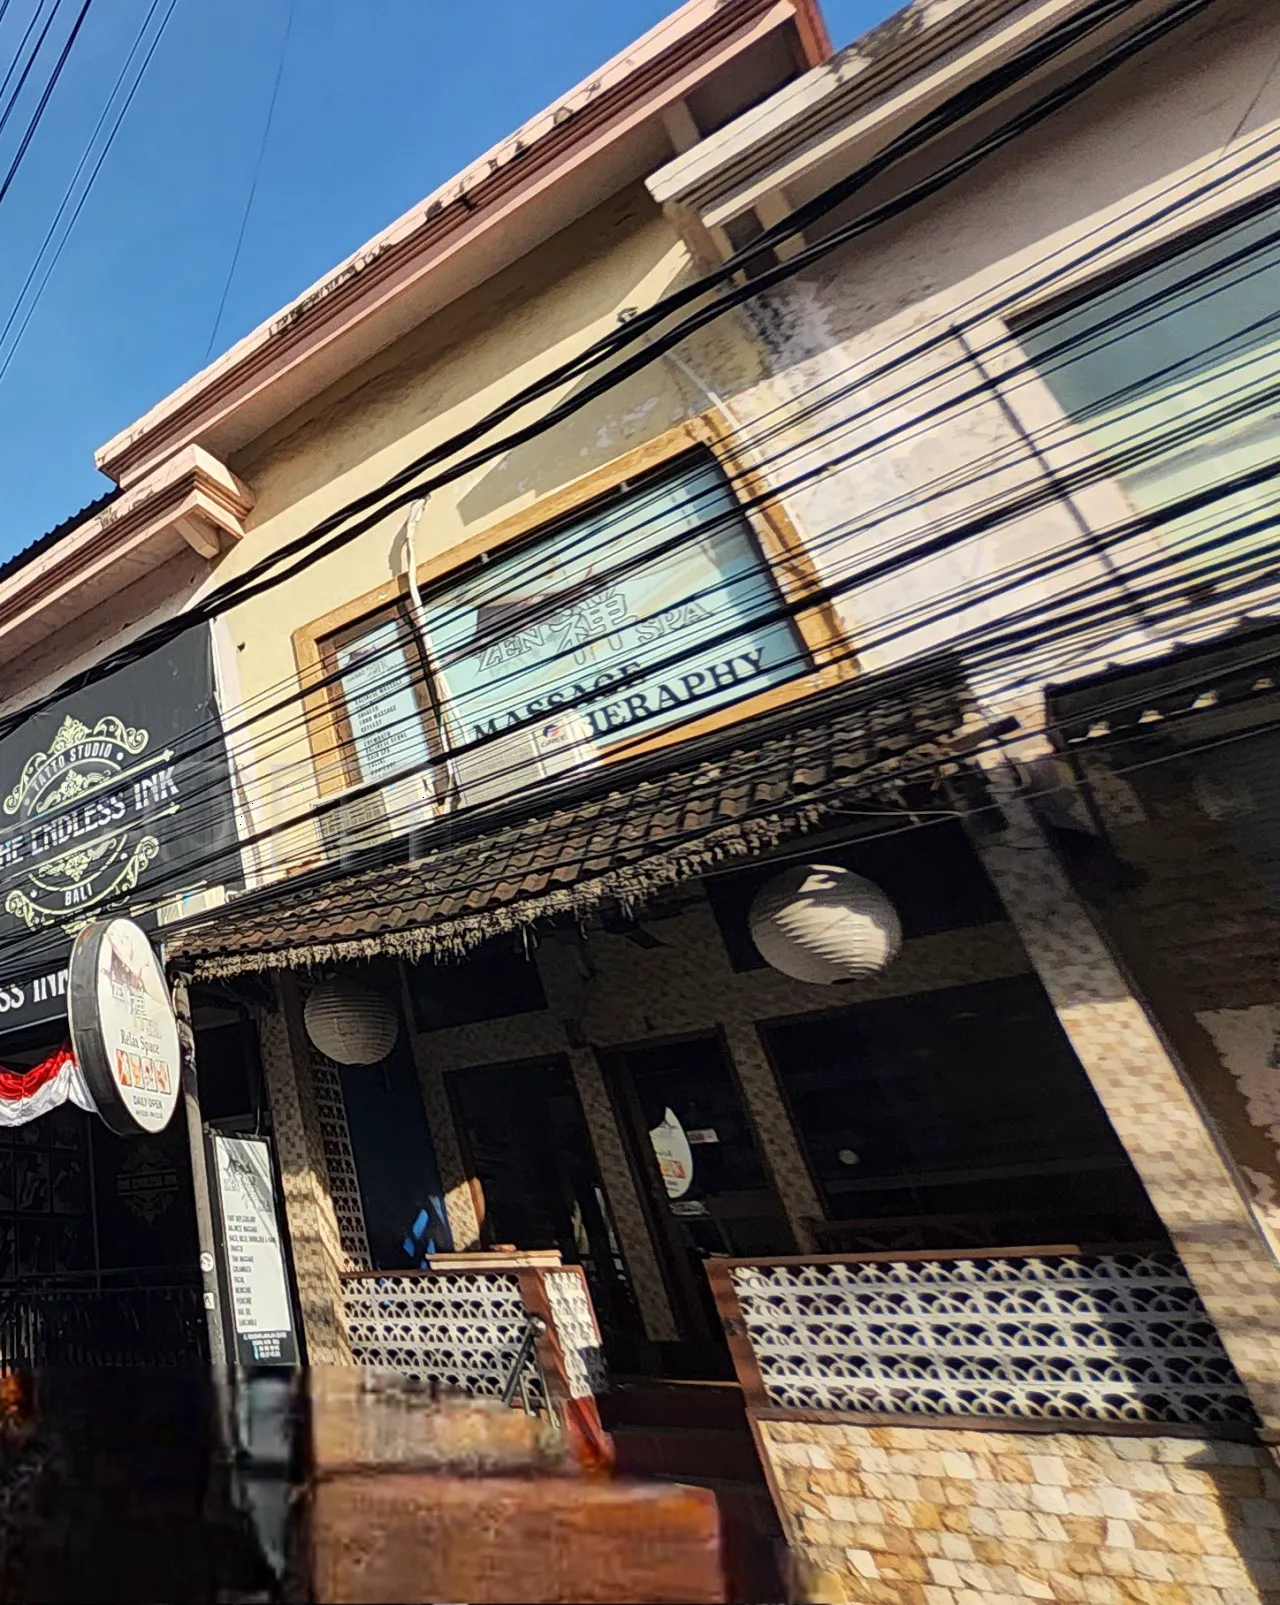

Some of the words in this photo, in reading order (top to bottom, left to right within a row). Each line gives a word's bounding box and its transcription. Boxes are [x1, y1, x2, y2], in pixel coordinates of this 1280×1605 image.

[475, 626, 545, 674] ZEN
[636, 601, 714, 644] SPA
[31, 755, 65, 792] TATTO
[69, 742, 113, 763] STUDIO
[30, 793, 126, 857] ENDLESS
[133, 765, 181, 812] INK
[65, 883, 93, 906] BALI
[120, 1029, 140, 1050] Relax
[140, 1035, 161, 1055] Space
